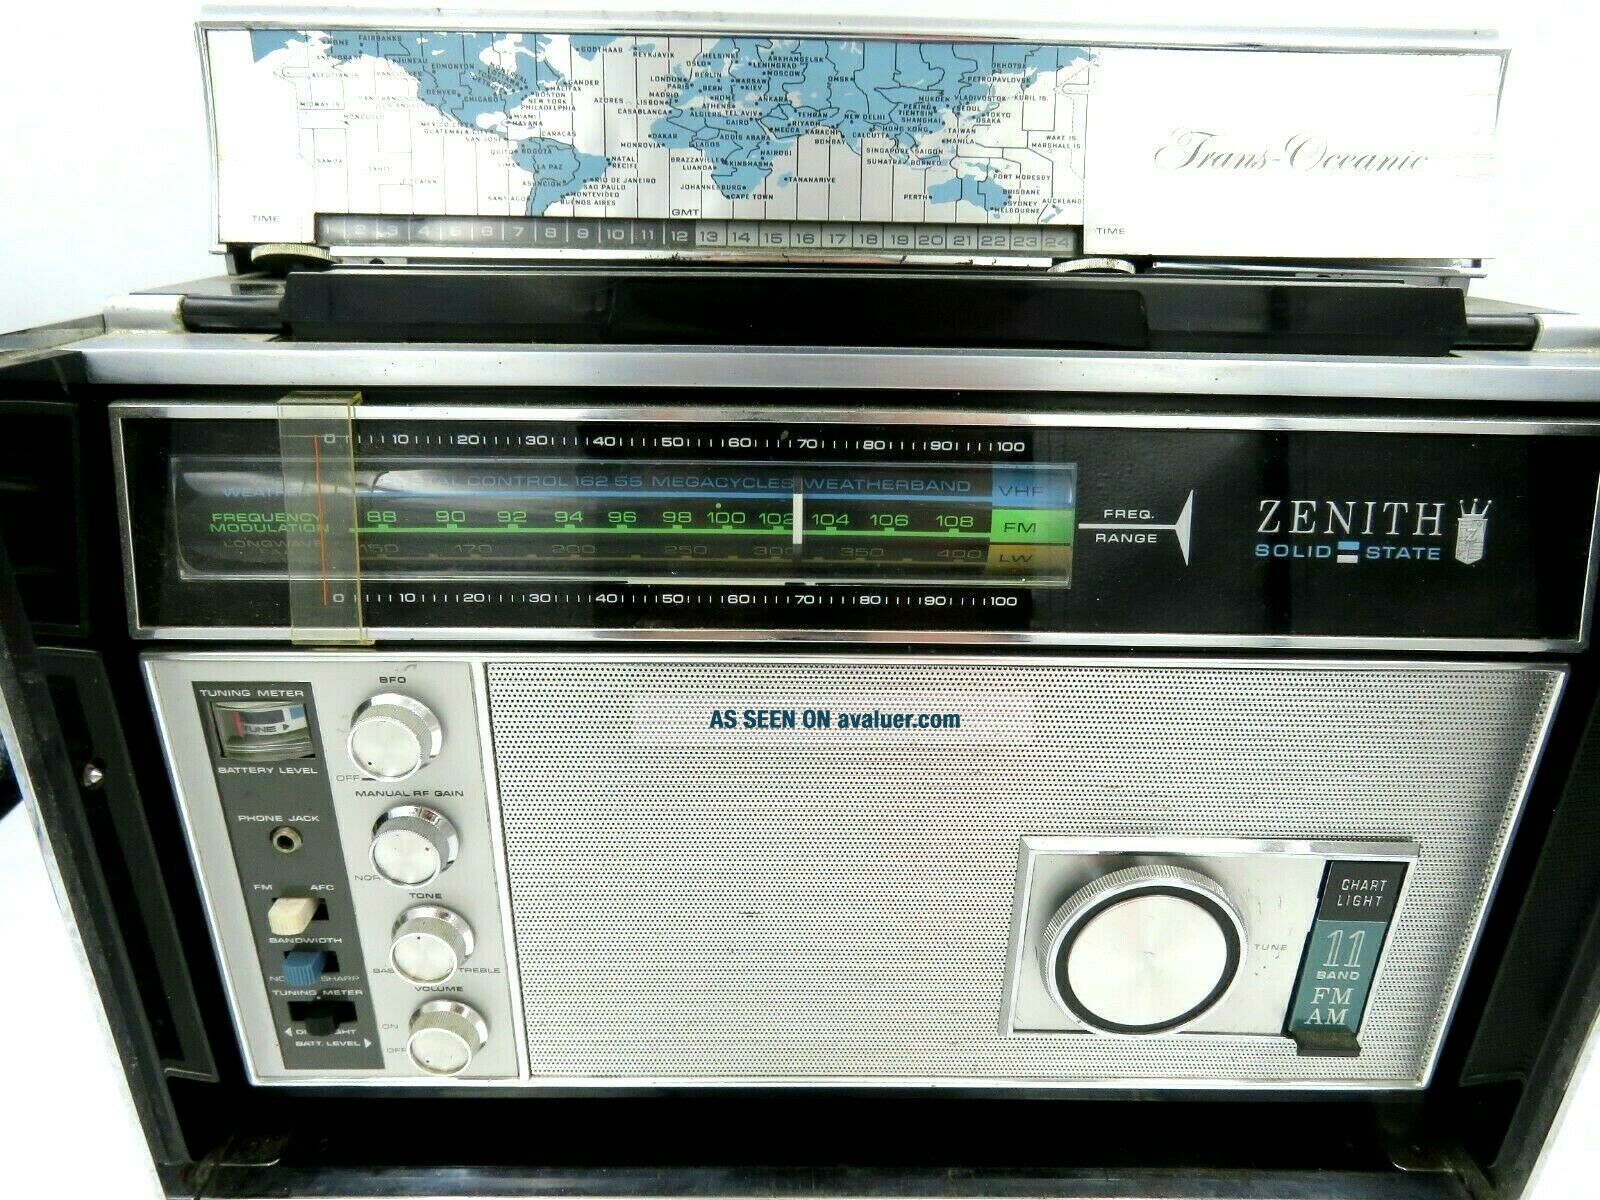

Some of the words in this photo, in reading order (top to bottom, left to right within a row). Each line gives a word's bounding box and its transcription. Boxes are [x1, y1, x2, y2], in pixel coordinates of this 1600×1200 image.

[1152, 127, 1429, 172] Trans-Oceanic
[671, 208, 700, 217] GMT
[1095, 227, 1125, 235] TIME
[514, 228, 524, 238] 7
[545, 228, 557, 238] 8
[577, 228, 589, 239] 9
[606, 229, 625, 240] 10
[641, 229, 655, 240] 11
[670, 231, 688, 242] 12
[700, 231, 718, 243] 13
[732, 231, 750, 243] 14
[764, 232, 783, 243] 15
[795, 232, 815, 244] 16
[829, 233, 845, 245] 17
[859, 233, 878, 245] 18
[890, 234, 909, 246] 19
[918, 234, 943, 246] 20
[953, 235, 972, 247] 21
[981, 235, 1005, 247] 22
[1013, 236, 1037, 247] 23
[1045, 236, 1070, 247] 24
[324, 434, 337, 444] 0
[392, 434, 410, 446] 10
[457, 435, 480, 446] 20
[525, 436, 548, 446] 30
[592, 436, 616, 447] 40
[661, 437, 684, 448] 50
[728, 437, 752, 448] 60
[797, 438, 818, 449] 70
[862, 440, 886, 451] 80
[929, 441, 953, 452] 90
[997, 441, 1025, 453] 100
[466, 476, 568, 488] CONTROL
[652, 476, 794, 489] MEGACYCLES
[804, 479, 971, 492] WEATHERBAND
[998, 486, 1045, 498] VHF
[212, 512, 321, 522] FREQUENCY
[1103, 509, 1155, 520] FREQ.
[1257, 500, 1446, 537] ZENITH
[366, 510, 398, 523] 88
[435, 511, 466, 523] 90
[497, 511, 528, 523] 92
[554, 511, 584, 523] 94
[607, 511, 638, 524] 96
[662, 511, 692, 524] 98
[707, 512, 746, 525] 100
[811, 513, 850, 527] 104
[869, 514, 909, 528] 106
[935, 514, 974, 528] 108
[1003, 521, 1036, 534] FM
[1096, 533, 1158, 544] RANGE
[1255, 544, 1331, 559] SOLID
[1366, 546, 1442, 561] STATE
[332, 593, 345, 603] 0
[399, 593, 416, 603] 10
[462, 593, 485, 603] 20
[528, 593, 551, 604] 30
[595, 593, 618, 604] 40
[662, 594, 684, 604] 50
[727, 594, 750, 605] 60
[794, 595, 815, 605] 70
[859, 595, 882, 606] 80
[923, 596, 947, 607] 90
[990, 597, 1018, 607] 100
[379, 675, 406, 684] BFO
[199, 689, 251, 698] TUNING
[257, 689, 305, 698] METER
[217, 766, 274, 776] BATTERY
[278, 767, 318, 776] LEVEL
[335, 774, 360, 783] OFF
[355, 789, 411, 798] MANUAL
[413, 789, 431, 798] RF
[434, 790, 465, 799] GAIN
[238, 815, 282, 823] PHONE
[288, 815, 321, 823] JACK
[253, 884, 273, 892] FM
[310, 884, 335, 892] AFC
[1341, 878, 1388, 891] CHART
[408, 892, 444, 900] TONE
[1336, 894, 1384, 907] LIGHT
[268, 937, 343, 945] BANDWIDTH
[1254, 944, 1289, 952] TUNE
[1322, 929, 1366, 968] 11
[459, 967, 501, 975] TREBLE
[1316, 970, 1361, 982] BAND
[322, 989, 364, 997] METER
[415, 985, 465, 993] VOLUME
[1310, 987, 1355, 1005] FM
[1304, 1008, 1350, 1025] AM
[327, 1040, 362, 1048] LEVEL
